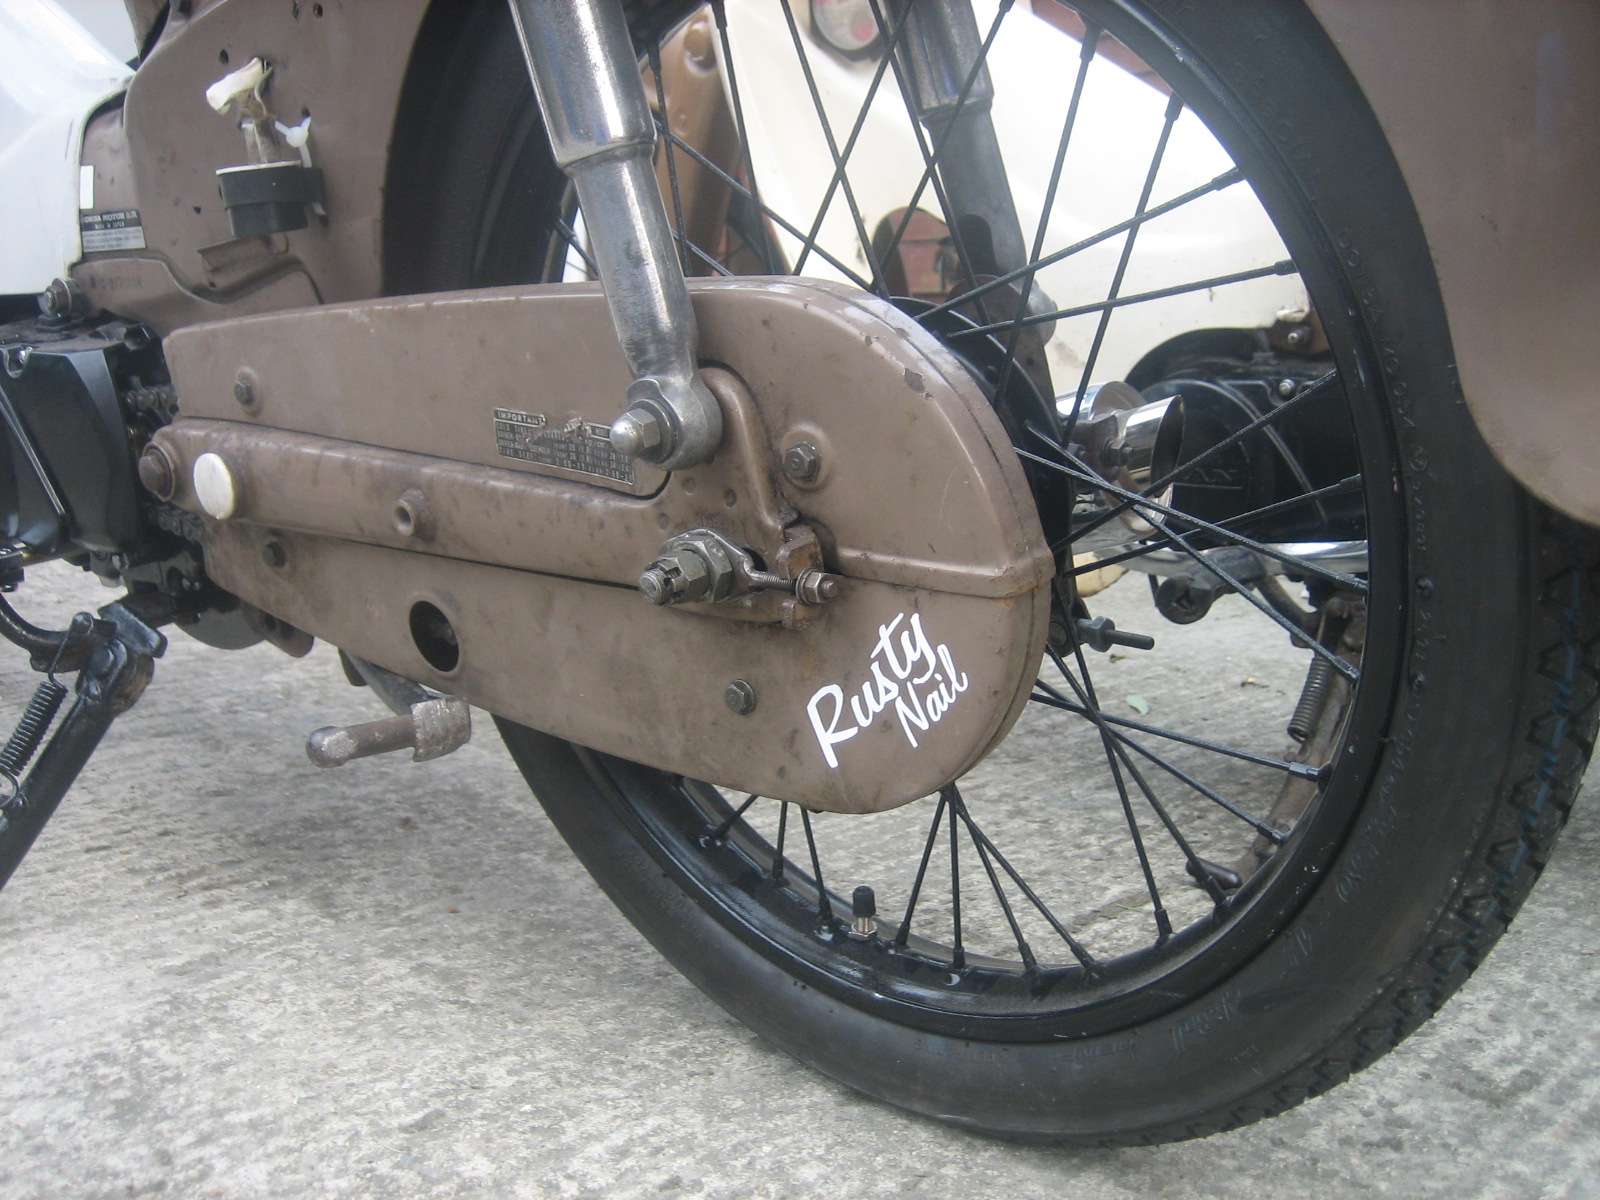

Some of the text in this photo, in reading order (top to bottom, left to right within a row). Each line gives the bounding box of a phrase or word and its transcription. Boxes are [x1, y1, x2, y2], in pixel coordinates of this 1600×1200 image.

[497, 411, 544, 426] IMPORTANT
[806, 612, 937, 768] Rusty
[895, 643, 968, 748] Nail
